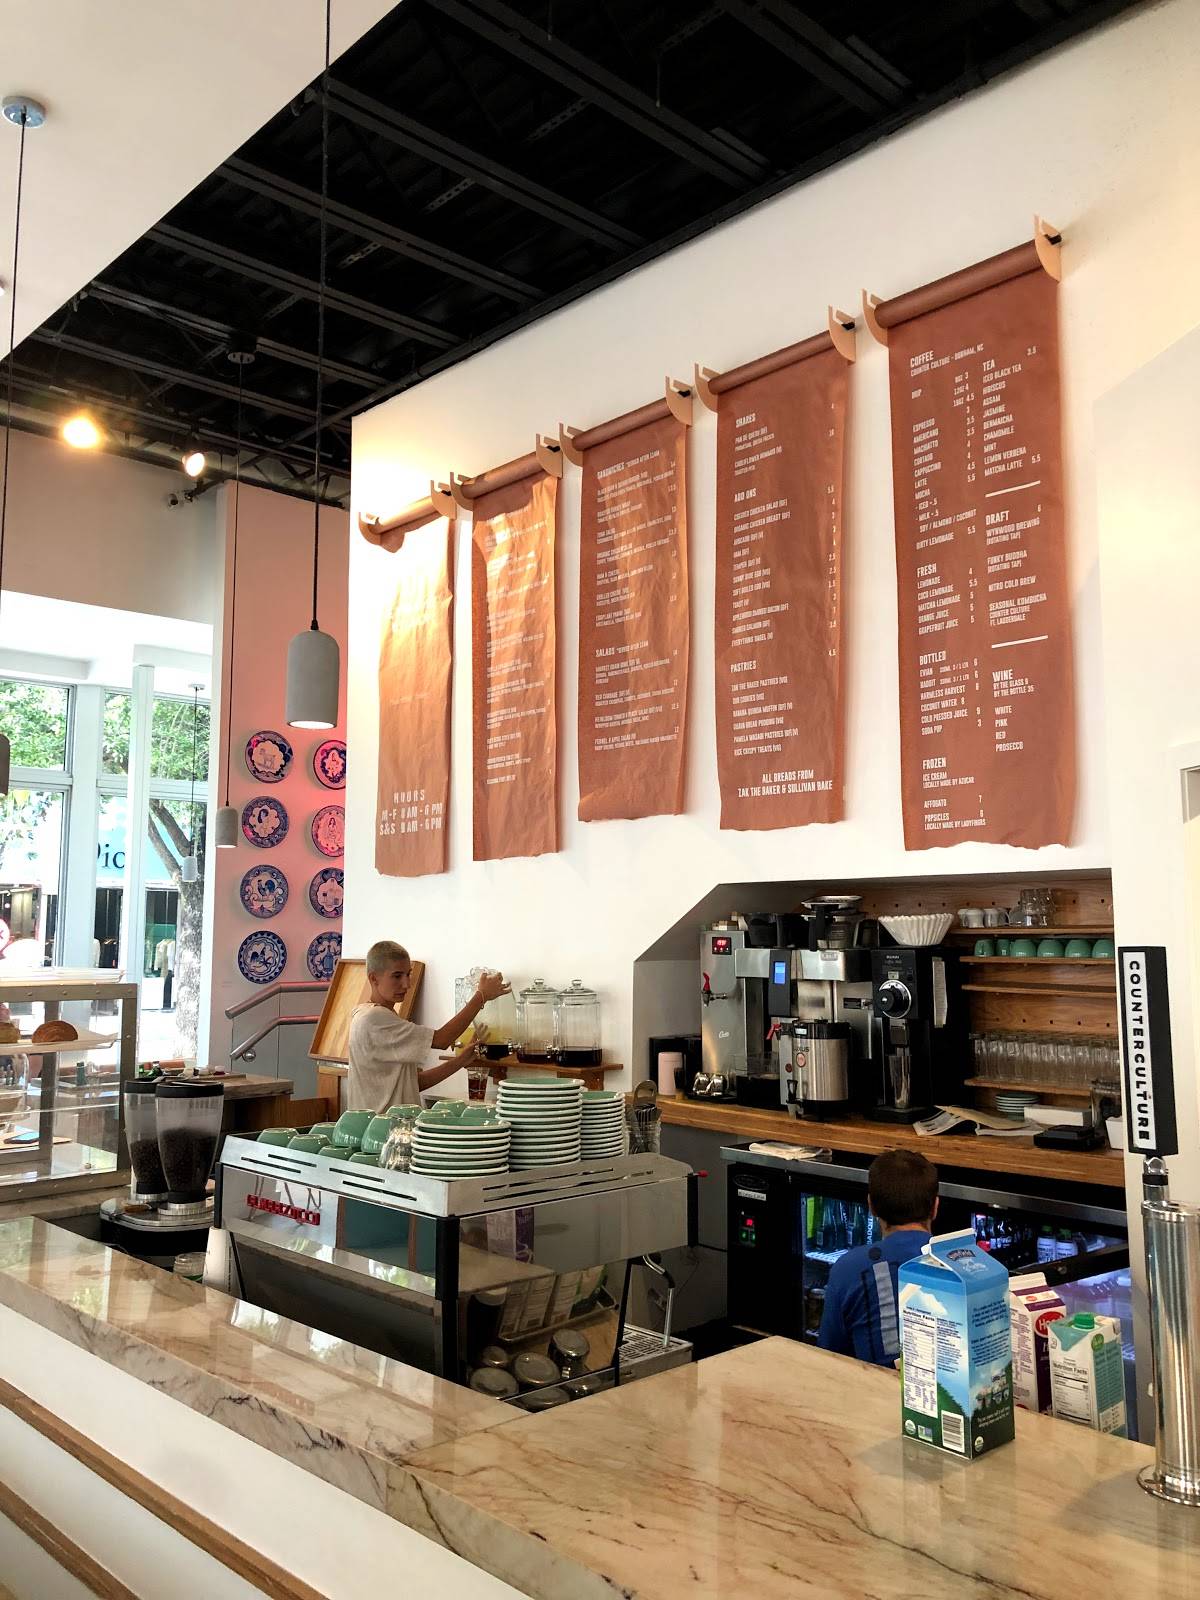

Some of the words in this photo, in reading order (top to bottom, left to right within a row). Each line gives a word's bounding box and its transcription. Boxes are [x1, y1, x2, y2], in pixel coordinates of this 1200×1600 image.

[910, 350, 933, 367] COFFEE
[930, 356, 949, 368] CULTURE
[982, 359, 994, 371] TEA
[982, 373, 993, 382] ICED
[994, 367, 1010, 378] BLACK
[1011, 363, 1021, 372] TEA
[982, 381, 1005, 394] HIBISCUS
[966, 392, 974, 401] 4.5
[982, 394, 1000, 405] ASSAM
[982, 404, 1005, 417] JASMINE
[912, 418, 934, 432] ESPRESSO
[983, 414, 1012, 429] GENMAICHA
[913, 428, 938, 442] AMERICANO
[983, 425, 1013, 440] CHAMOMILE
[983, 442, 996, 452] MINT
[984, 453, 1001, 464] LEMON
[1002, 446, 1026, 458] VERBENA
[914, 462, 941, 476] CAPPUCCINO
[984, 464, 1005, 476] MATCHA
[1006, 459, 1022, 470] LATTE
[1031, 453, 1040, 463] 5.5
[914, 477, 927, 488] LATTE
[915, 488, 930, 499] MOCHA
[967, 473, 975, 482] 5.5
[918, 500, 928, 509] ICED
[919, 523, 928, 532] SOY
[932, 517, 951, 528] ALMOND
[956, 509, 976, 521] COCONUT
[985, 510, 1009, 524] DRAFT
[986, 524, 1014, 536] WYNWOOD
[1016, 517, 1039, 530] BREWING
[916, 539, 928, 549] DIRTY
[929, 532, 953, 545] LEMONADE
[967, 525, 975, 534] 5.5
[987, 554, 1003, 564] FUNKY
[1005, 550, 1027, 560] BUDDHA
[917, 563, 936, 576] FRESH
[917, 576, 940, 588] LEMONADE
[929, 584, 953, 596] LEMONADE
[969, 578, 977, 587] 5.5
[988, 582, 1003, 591] NITRO
[1004, 579, 1018, 588] COLD
[1019, 575, 1036, 585] BREW
[918, 601, 935, 611] MATCHA
[936, 594, 960, 606] LEMONADE
[989, 599, 1016, 611] SEASONAL
[1016, 593, 1046, 605] KOMBUCHA
[918, 612, 934, 623] ORANGE
[935, 609, 949, 618] JUICE
[989, 609, 1009, 618] COUNTER
[1009, 605, 1029, 614] CULTURE
[918, 622, 944, 634] GRAPEFRUIT
[945, 618, 958, 628] JUICE
[919, 650, 945, 664] BOTTLED
[730, 660, 756, 672] PASTRIES
[992, 669, 1012, 681] WINE
[1009, 678, 1024, 686] GLASS
[920, 689, 943, 699] HARMLESS
[944, 685, 965, 695] HARVEST
[1000, 688, 1010, 696] THE
[1009, 686, 1028, 694] BOTTLE
[920, 701, 941, 711] COCONUT
[940, 698, 957, 707] WATER
[994, 705, 1011, 714] WHITE
[921, 714, 932, 723] COLD
[933, 711, 952, 720] PRESSED
[953, 708, 968, 718] JUICE
[995, 718, 1007, 726] PINK
[921, 726, 933, 735] SODA
[933, 724, 942, 732] POP
[995, 731, 1005, 739] RED
[995, 741, 1023, 751] PROSECCO
[922, 757, 946, 769] FROZEN
[762, 773, 772, 783] ALL
[773, 771, 796, 781] BREADS
[797, 769, 813, 779] FROM
[930, 771, 947, 780] CREAM
[737, 788, 749, 797] ZAK
[750, 786, 760, 796] THE
[762, 785, 780, 795] BAKER
[787, 782, 815, 792] SULLIVAN
[816, 780, 832, 790] BAKE
[922, 780, 939, 788] LOCALLY
[393, 790, 425, 804] HOURS
[924, 799, 946, 807] AFFOGATO
[924, 812, 949, 821] POPSICLES
[379, 823, 396, 836] S&S
[1129, 960, 1150, 1140] COUNTERCULTURE
[1073, 1366, 1087, 1375] Facts
